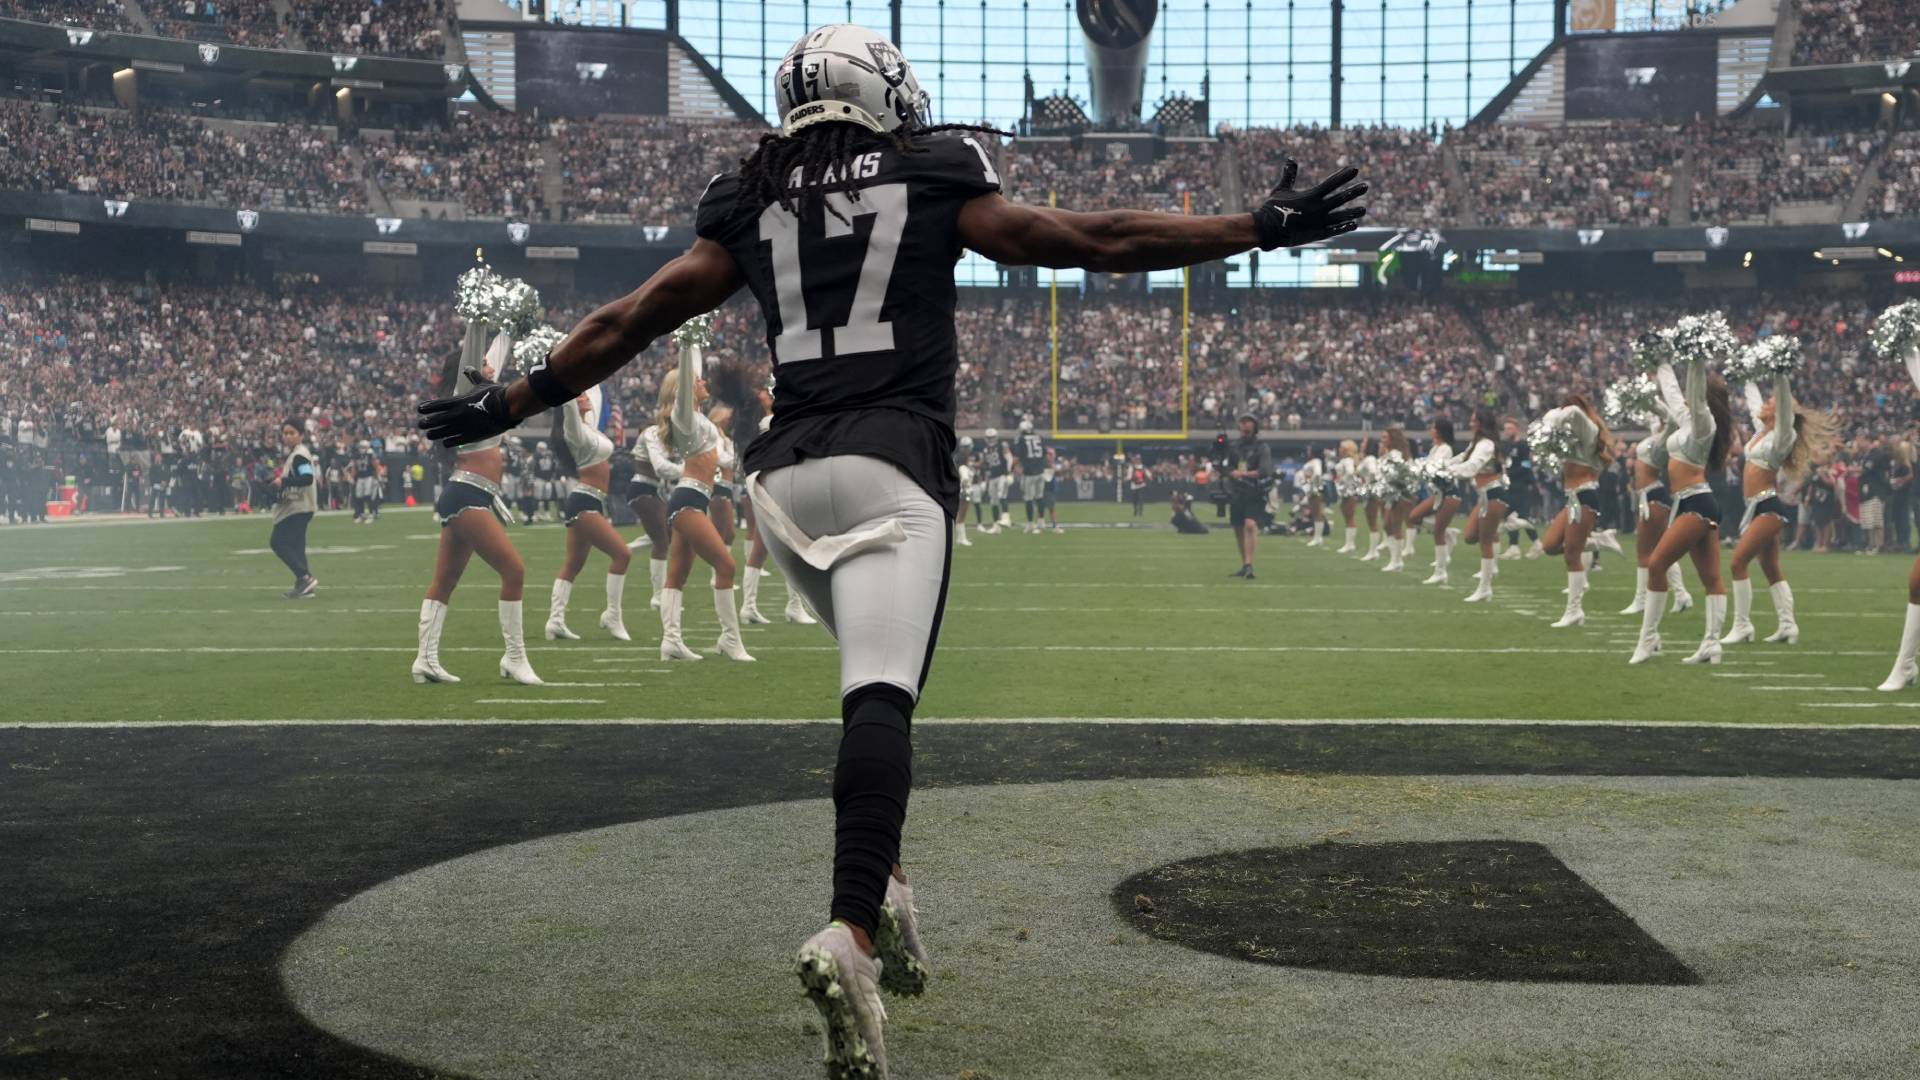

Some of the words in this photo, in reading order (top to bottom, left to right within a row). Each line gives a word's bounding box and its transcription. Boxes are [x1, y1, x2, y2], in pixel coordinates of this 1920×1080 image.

[790, 104, 825, 123] RAIDERS
[787, 152, 883, 189] AAMS
[758, 182, 908, 365] 17
[1025, 439, 1043, 458] 15
